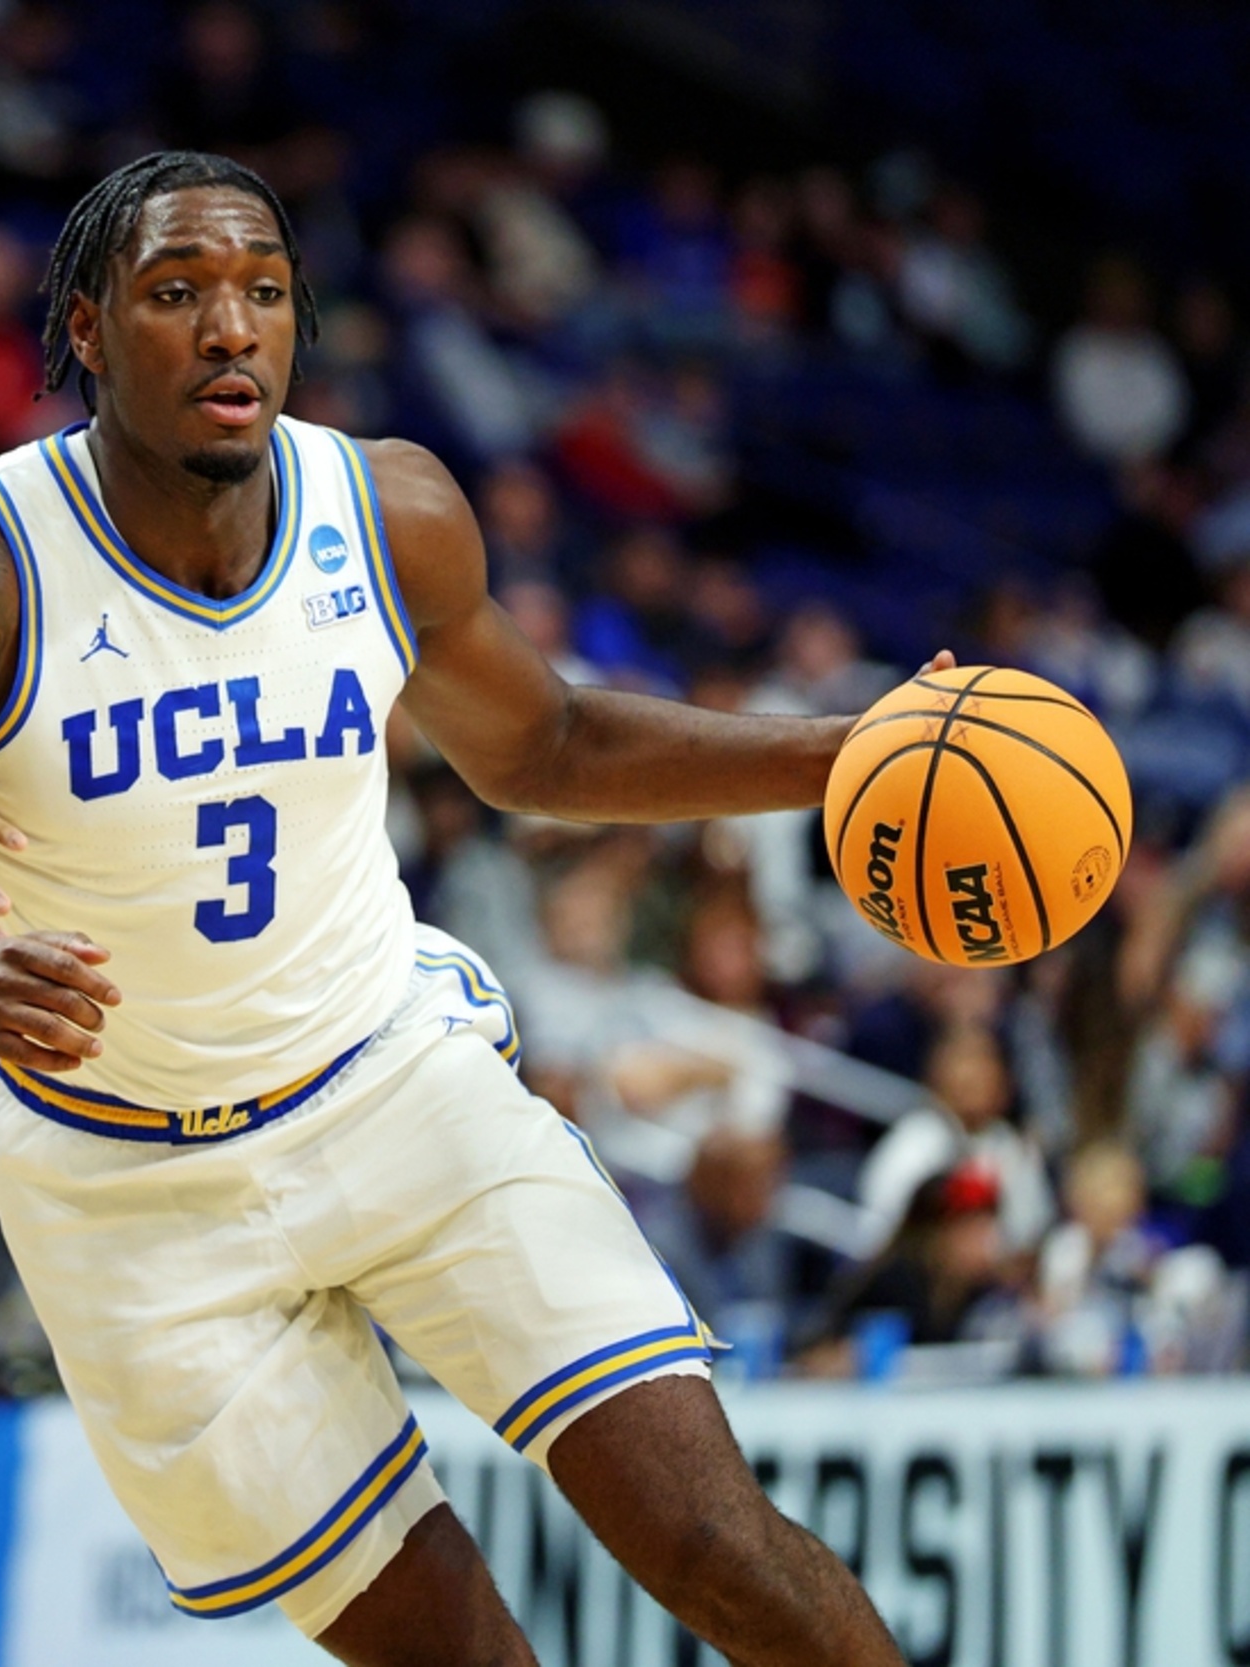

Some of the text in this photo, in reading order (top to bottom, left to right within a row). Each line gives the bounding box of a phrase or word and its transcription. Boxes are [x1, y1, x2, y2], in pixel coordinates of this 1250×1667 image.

[62, 669, 376, 802] UCLA
[194, 794, 277, 944] 3
[945, 863, 1011, 963] NCAA
